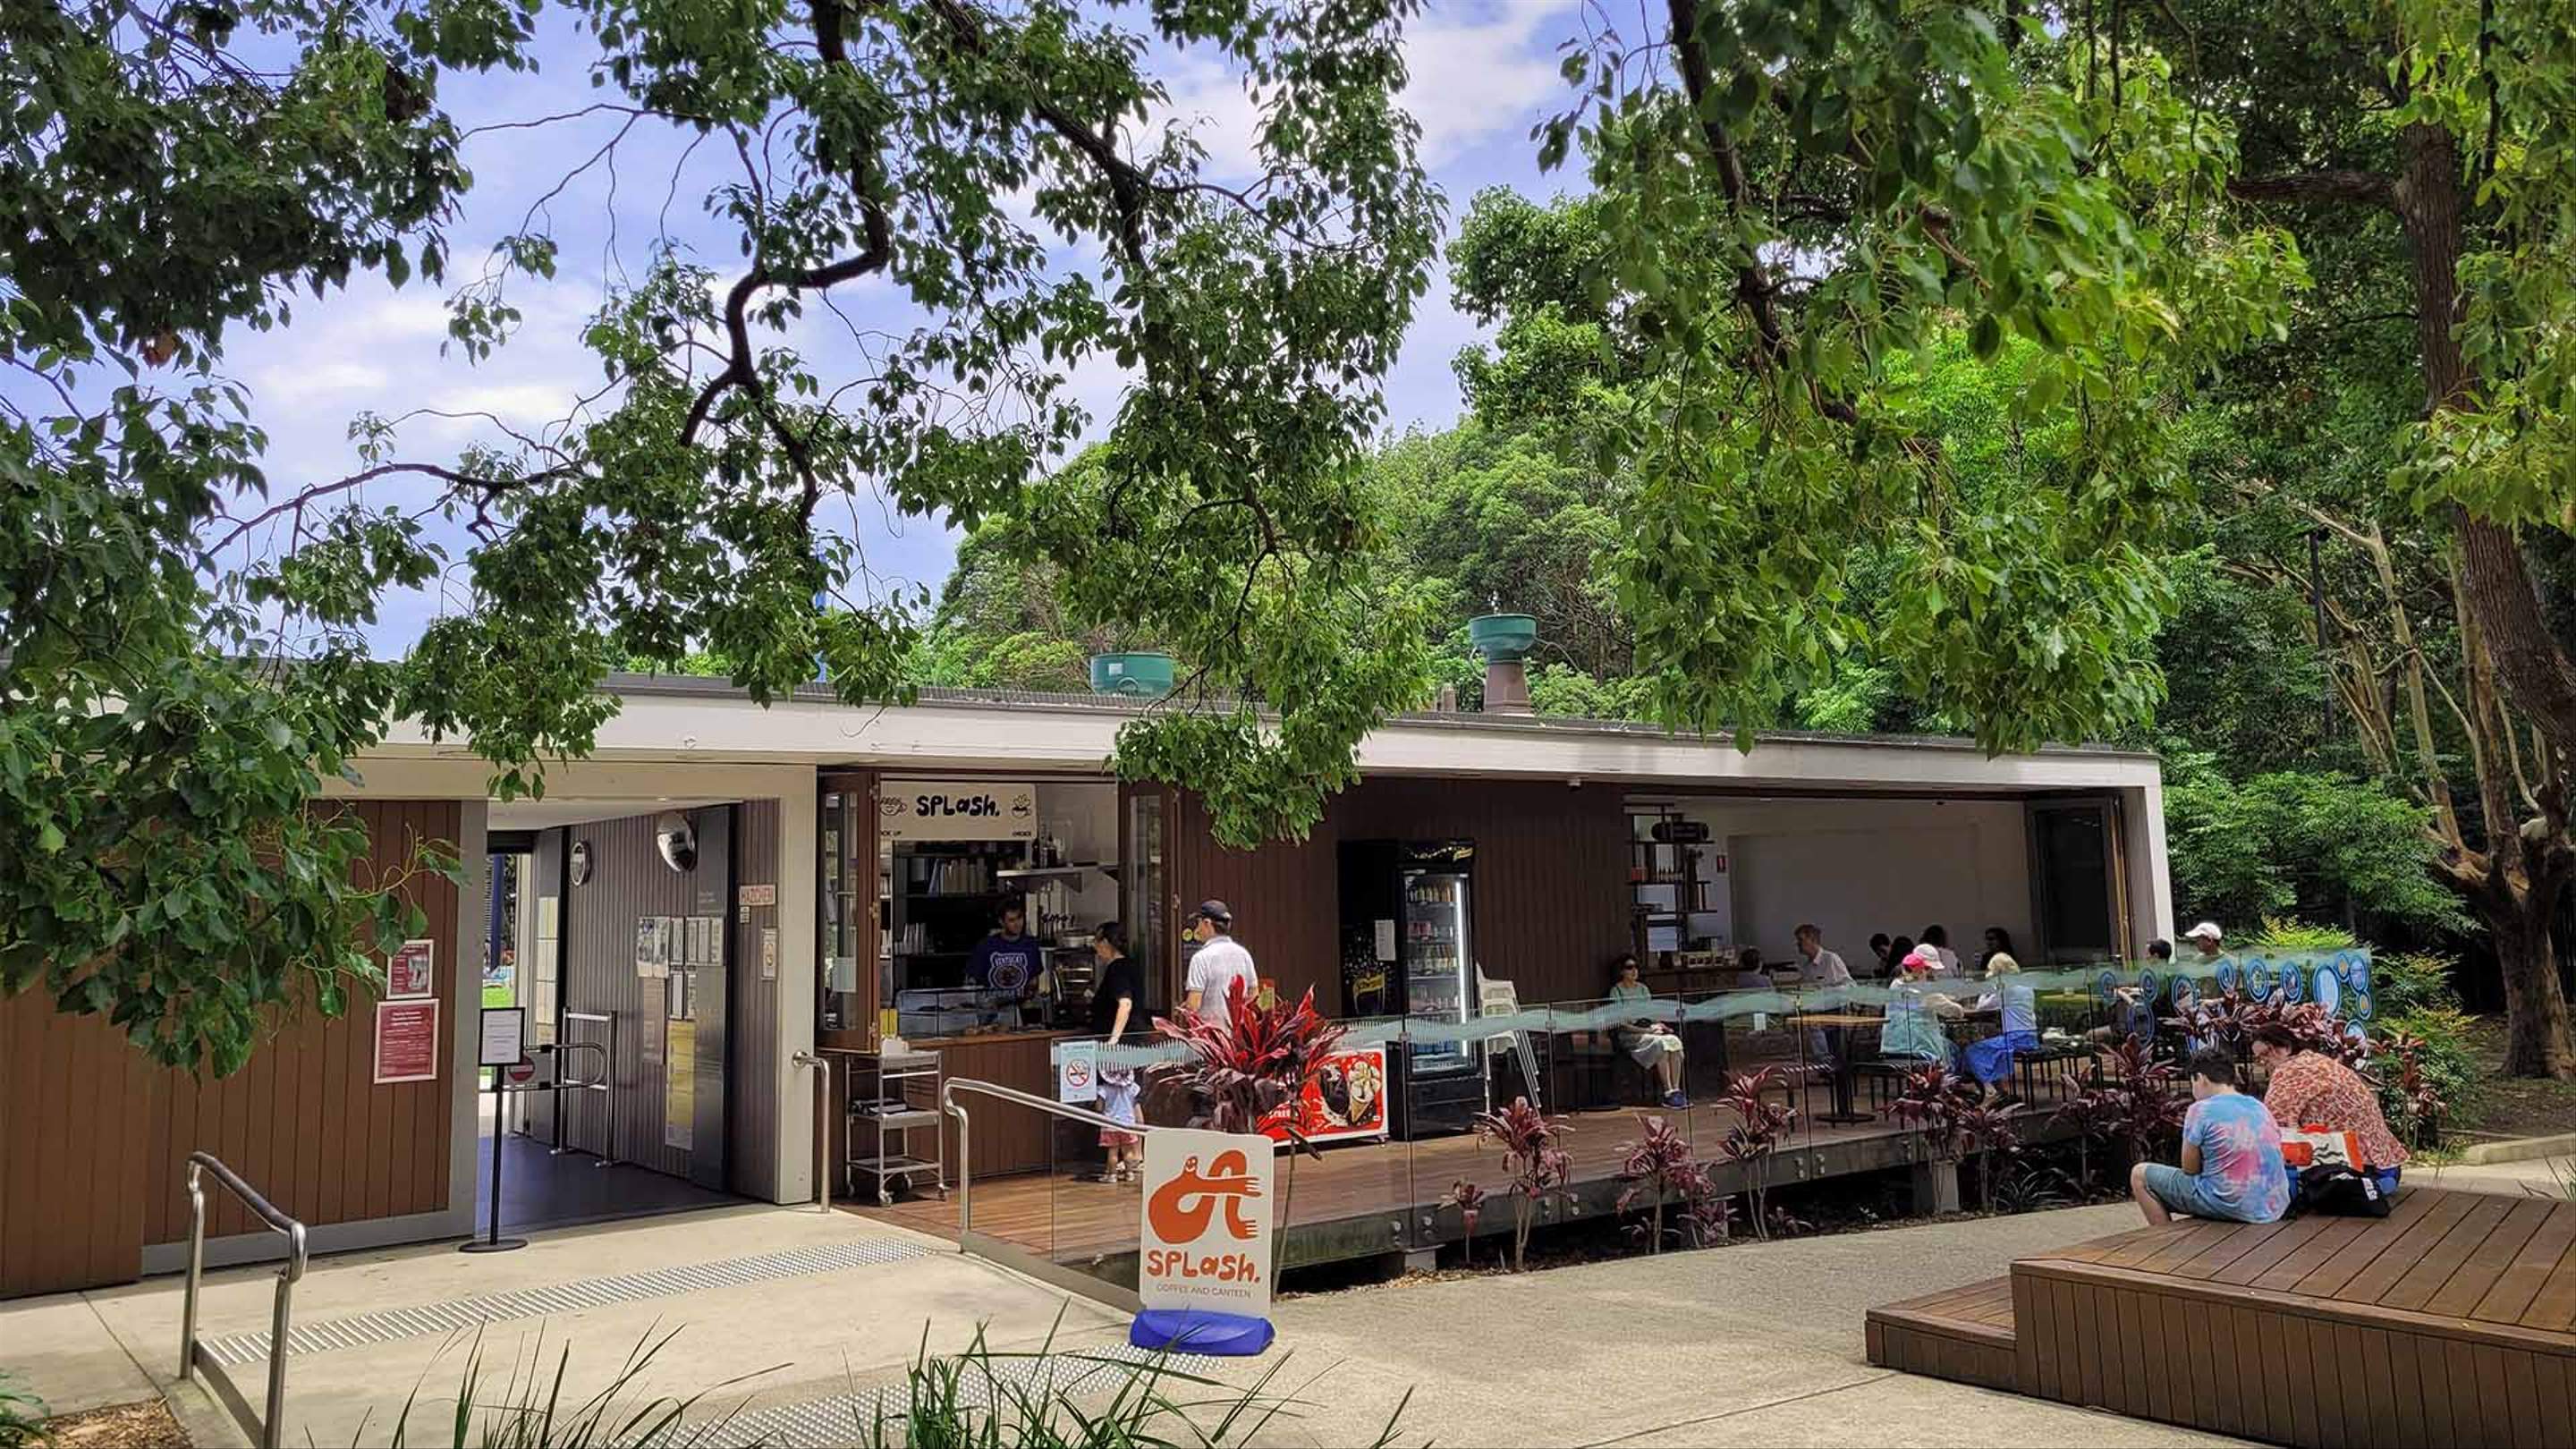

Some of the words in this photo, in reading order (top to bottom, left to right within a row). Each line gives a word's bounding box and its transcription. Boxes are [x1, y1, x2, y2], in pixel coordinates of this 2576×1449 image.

[1157, 1284, 1189, 1294] COFFEE
[1191, 1287, 1210, 1296] AND
[1212, 1288, 1251, 1299] CANTEEN
